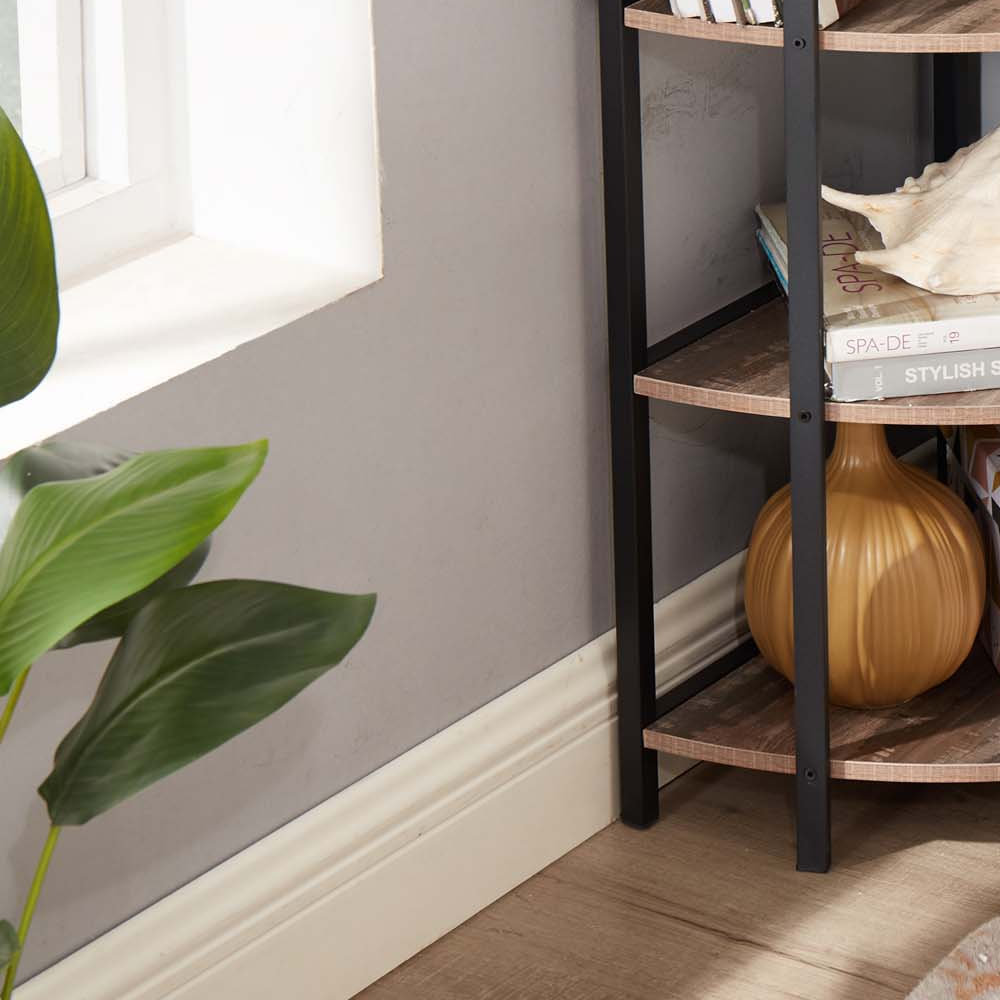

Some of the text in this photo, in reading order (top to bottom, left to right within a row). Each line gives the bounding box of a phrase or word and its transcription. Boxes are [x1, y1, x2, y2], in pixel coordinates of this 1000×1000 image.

[822, 231, 883, 293] SPA-DE
[846, 334, 912, 355] SPA-DE
[905, 362, 985, 383] STYLISH
